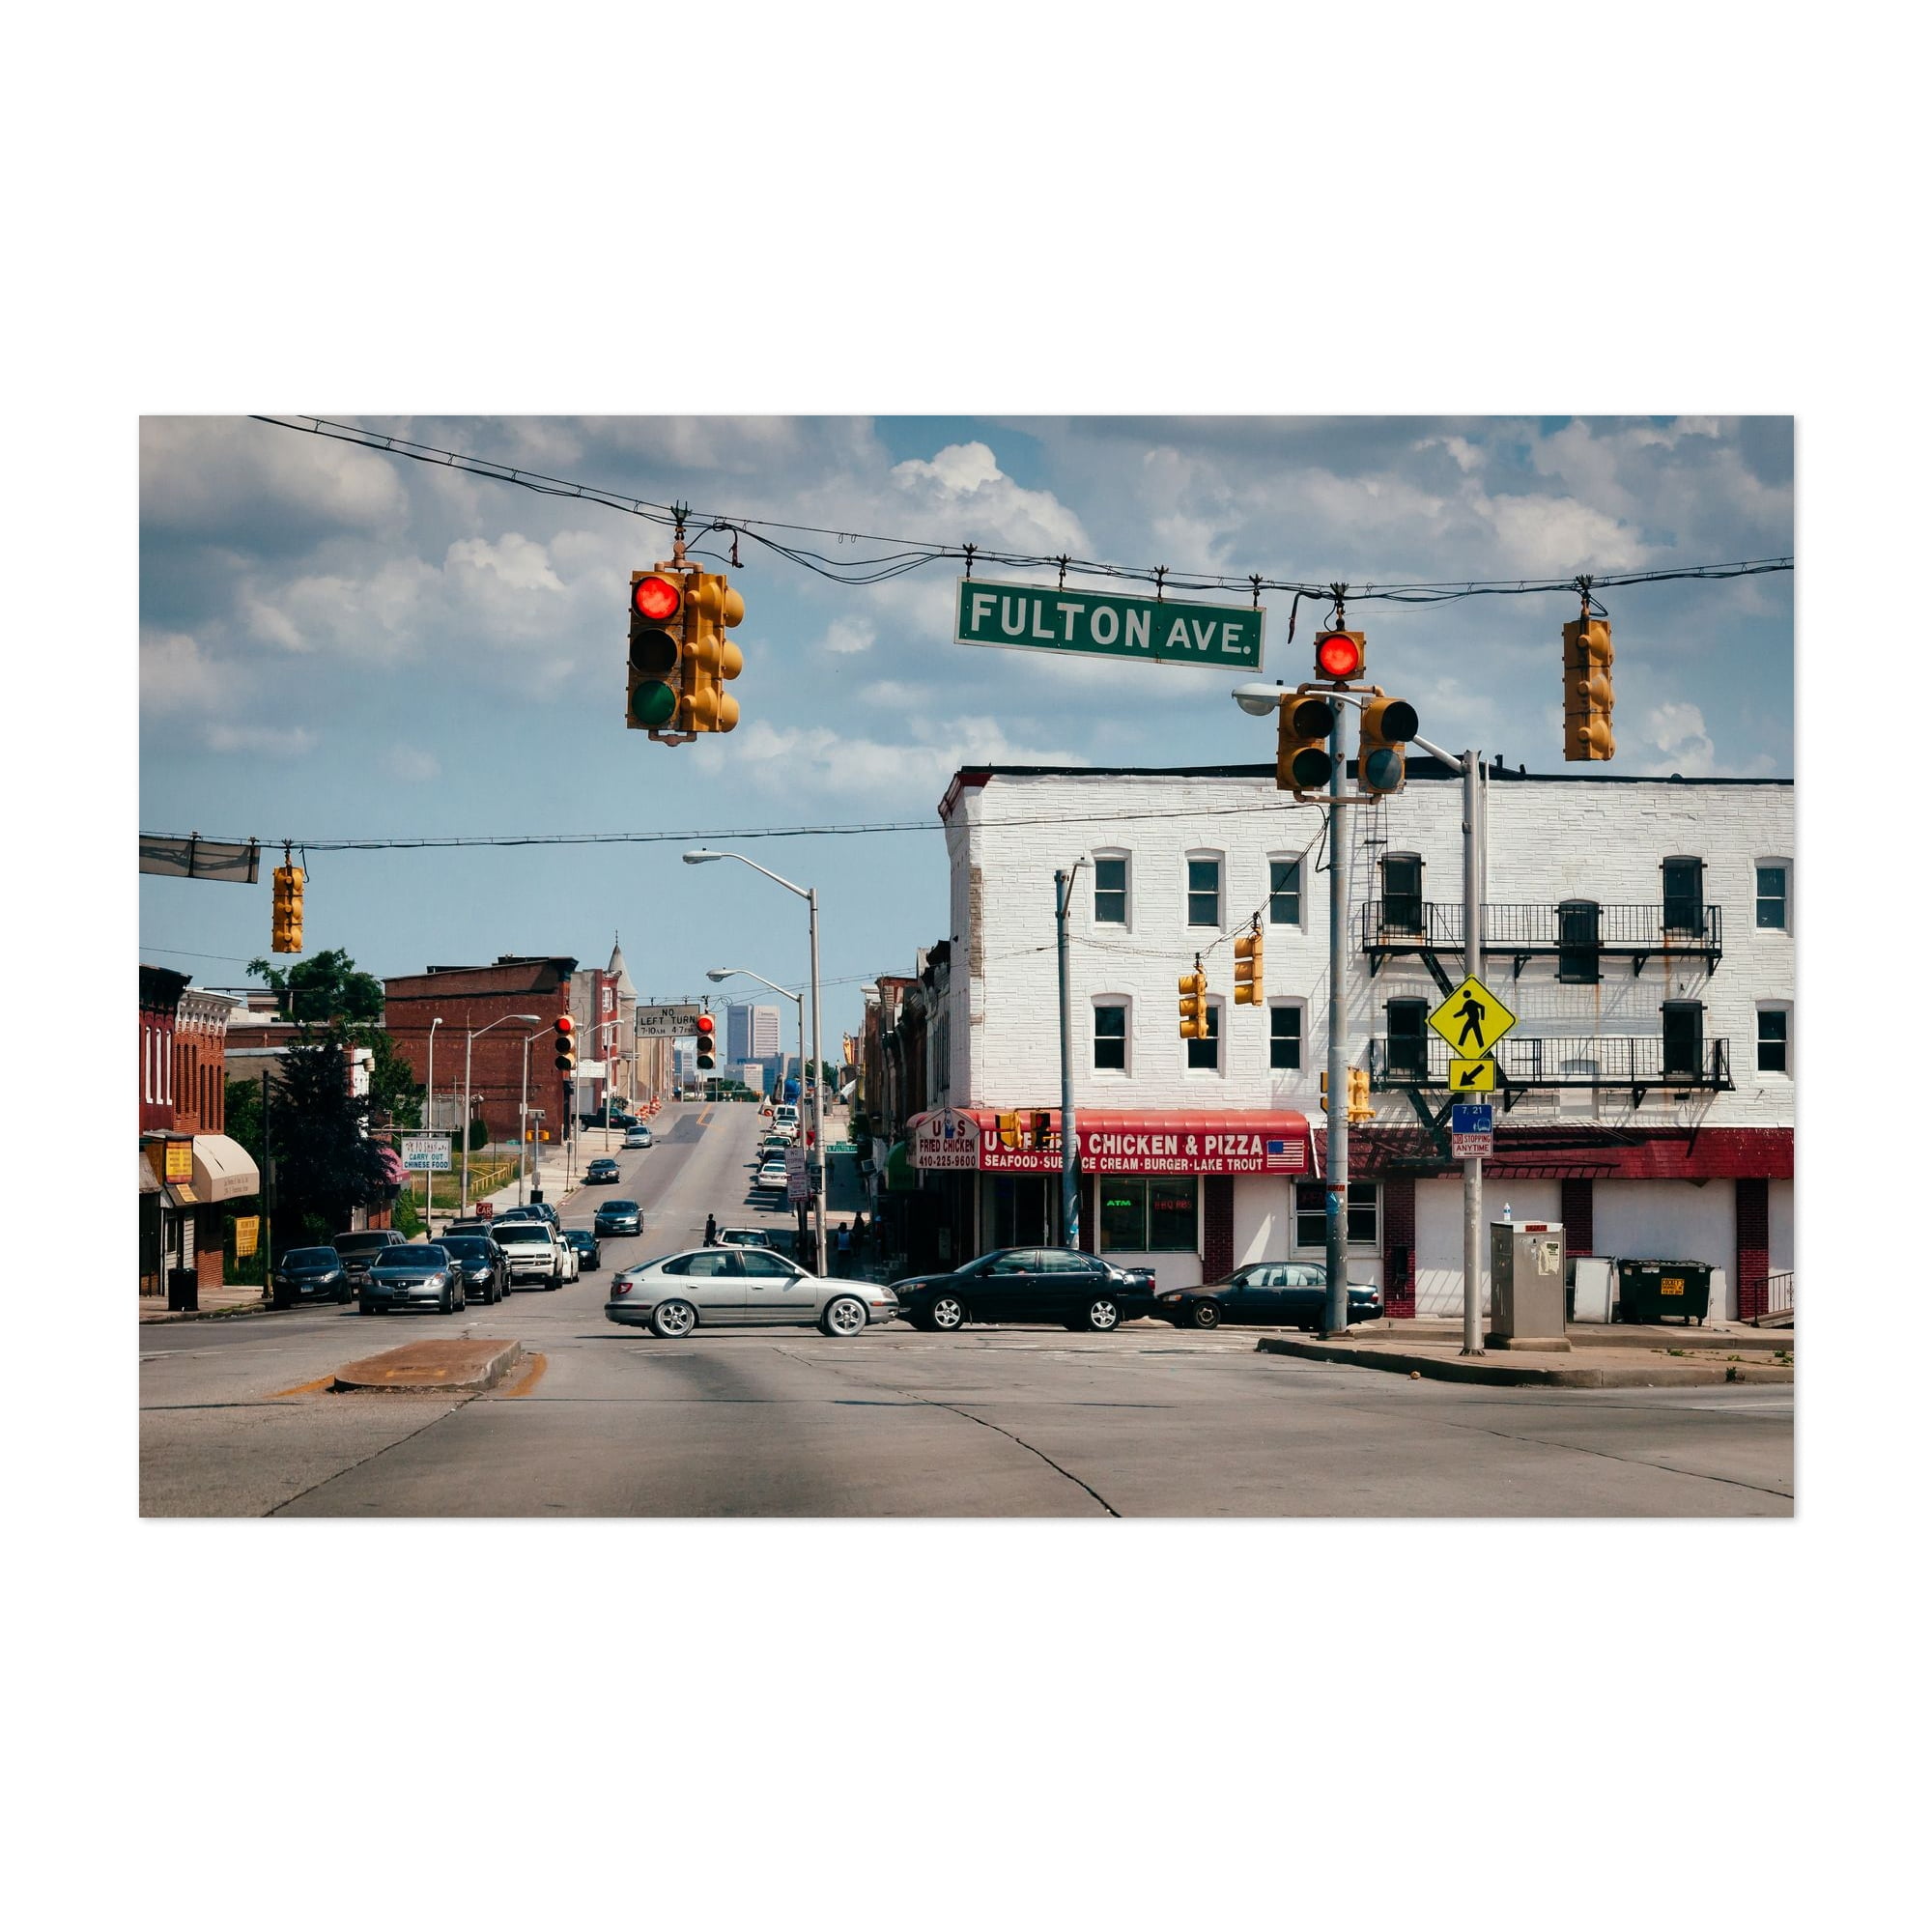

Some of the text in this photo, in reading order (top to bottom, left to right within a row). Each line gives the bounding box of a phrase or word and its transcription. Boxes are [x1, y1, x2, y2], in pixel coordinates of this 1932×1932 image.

[971, 592, 1251, 655] FULTON AVE.
[640, 1015, 696, 1026] LEFT TURN
[932, 1120, 966, 1137] U S
[919, 1139, 975, 1153] FRIED CHICKEN
[984, 1130, 998, 1151] U
[1089, 1133, 1178, 1155] CHICKEN
[1185, 1134, 1199, 1156] &
[1205, 1134, 1264, 1156] PIZZA
[1453, 1134, 1491, 1144] NO STOPPING
[919, 1155, 976, 1167] 410-225-9600
[984, 1154, 1038, 1168] SEAFOOD
[1100, 1157, 1139, 1171] CREAM
[1144, 1158, 1189, 1171] BURGER
[1194, 1159, 1223, 1171] LAKE
[1227, 1159, 1264, 1171] TROUT
[476, 1207, 492, 1215] CAR
